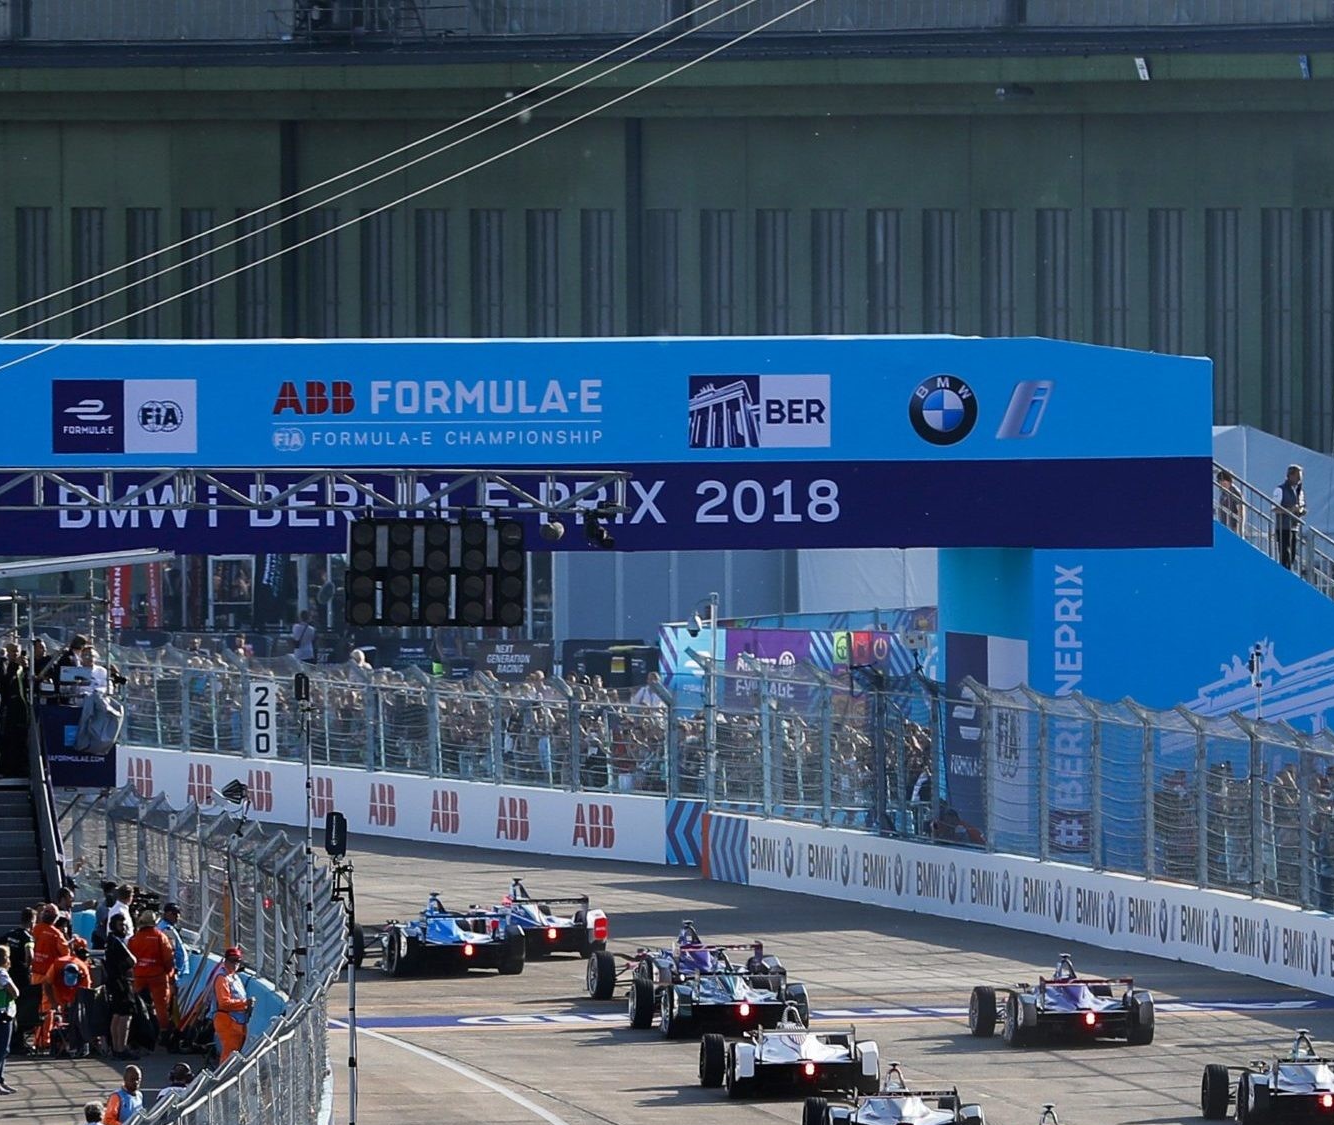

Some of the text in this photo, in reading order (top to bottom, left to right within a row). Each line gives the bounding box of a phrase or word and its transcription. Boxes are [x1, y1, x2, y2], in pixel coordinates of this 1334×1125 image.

[272, 379, 602, 416] ABB FORMULA-E
[767, 399, 826, 424] BER
[63, 425, 115, 435] FORMULA-E
[312, 431, 433, 446] FORMULA-E
[445, 430, 602, 445] CHAMPIONSHIP
[58, 482, 190, 527] BMW
[208, 482, 218, 526] i
[696, 479, 841, 524] 2018
[486, 654, 531, 665] GENERATION
[495, 644, 517, 654] NEXT
[496, 662, 525, 675] RACING
[254, 686, 270, 754] 200
[128, 758, 153, 798] ABB
[188, 763, 213, 805] ABB
[248, 770, 273, 813] ABB
[369, 783, 396, 828] ABB
[431, 790, 460, 834] ABB
[496, 797, 531, 842] ABB
[572, 803, 616, 850] ABB
[750, 836, 776, 872] BMW
[808, 845, 833, 881] BMW
[863, 853, 888, 889] BMW
[917, 861, 941, 899] BMW
[971, 868, 995, 907] BMW
[1024, 877, 1047, 916] BMW
[1076, 888, 1101, 928] BMW
[1128, 897, 1153, 937] BMW
[1181, 905, 1205, 946] BMW
[1233, 916, 1257, 957] BMW
[1283, 928, 1306, 970] BMW
